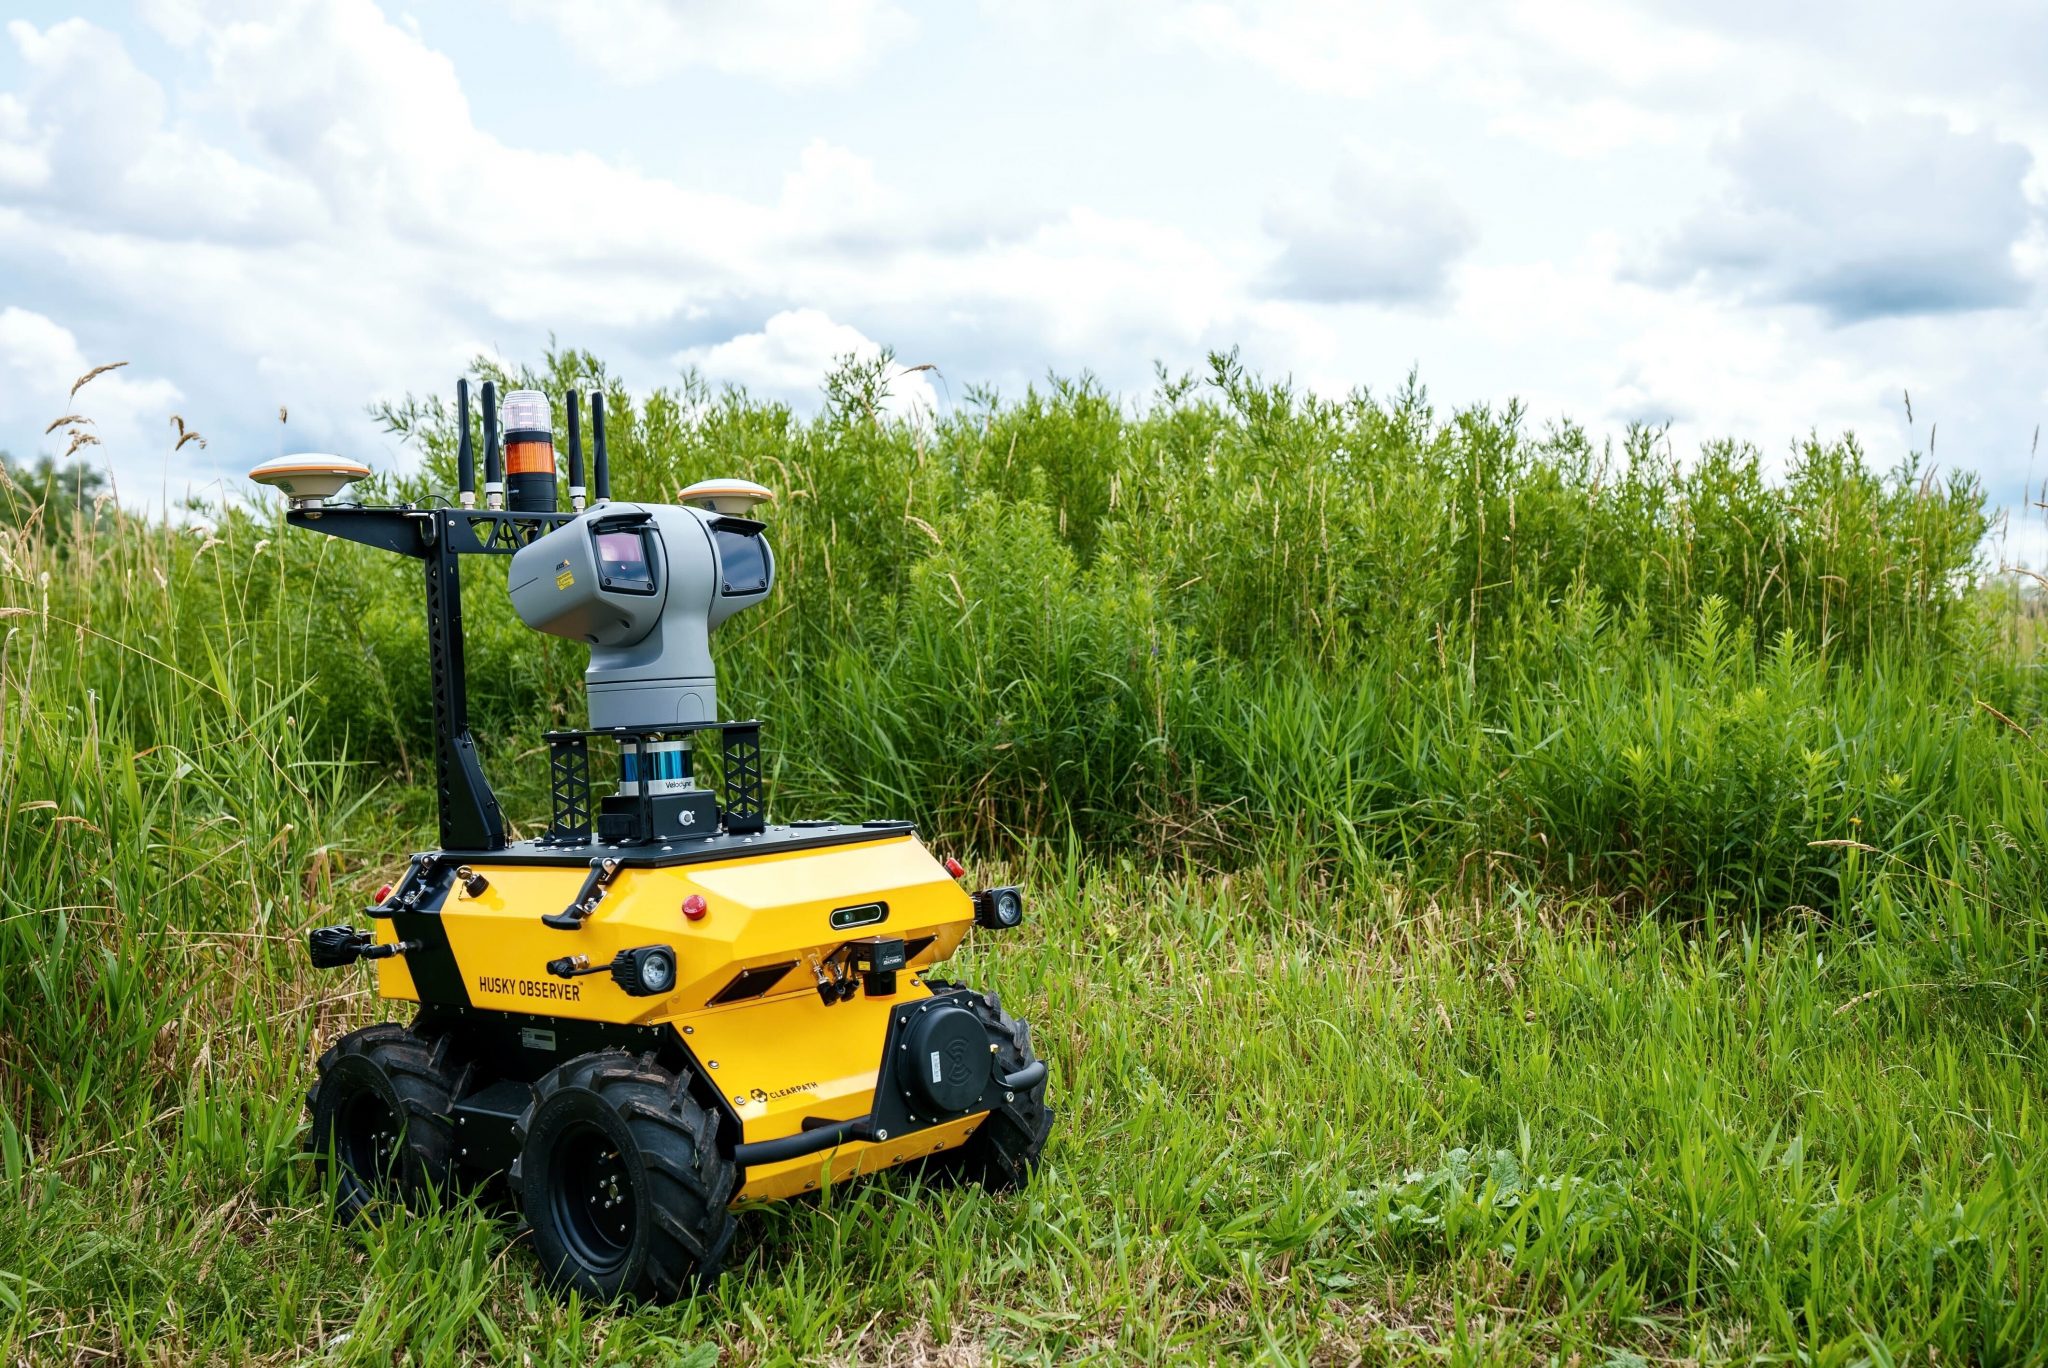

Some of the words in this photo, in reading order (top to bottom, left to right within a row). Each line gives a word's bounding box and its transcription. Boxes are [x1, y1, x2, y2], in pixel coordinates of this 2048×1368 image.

[479, 976, 516, 995] HUSKY
[519, 980, 580, 1001] OBSERVER
[769, 1081, 818, 1099] CLEARPATH
